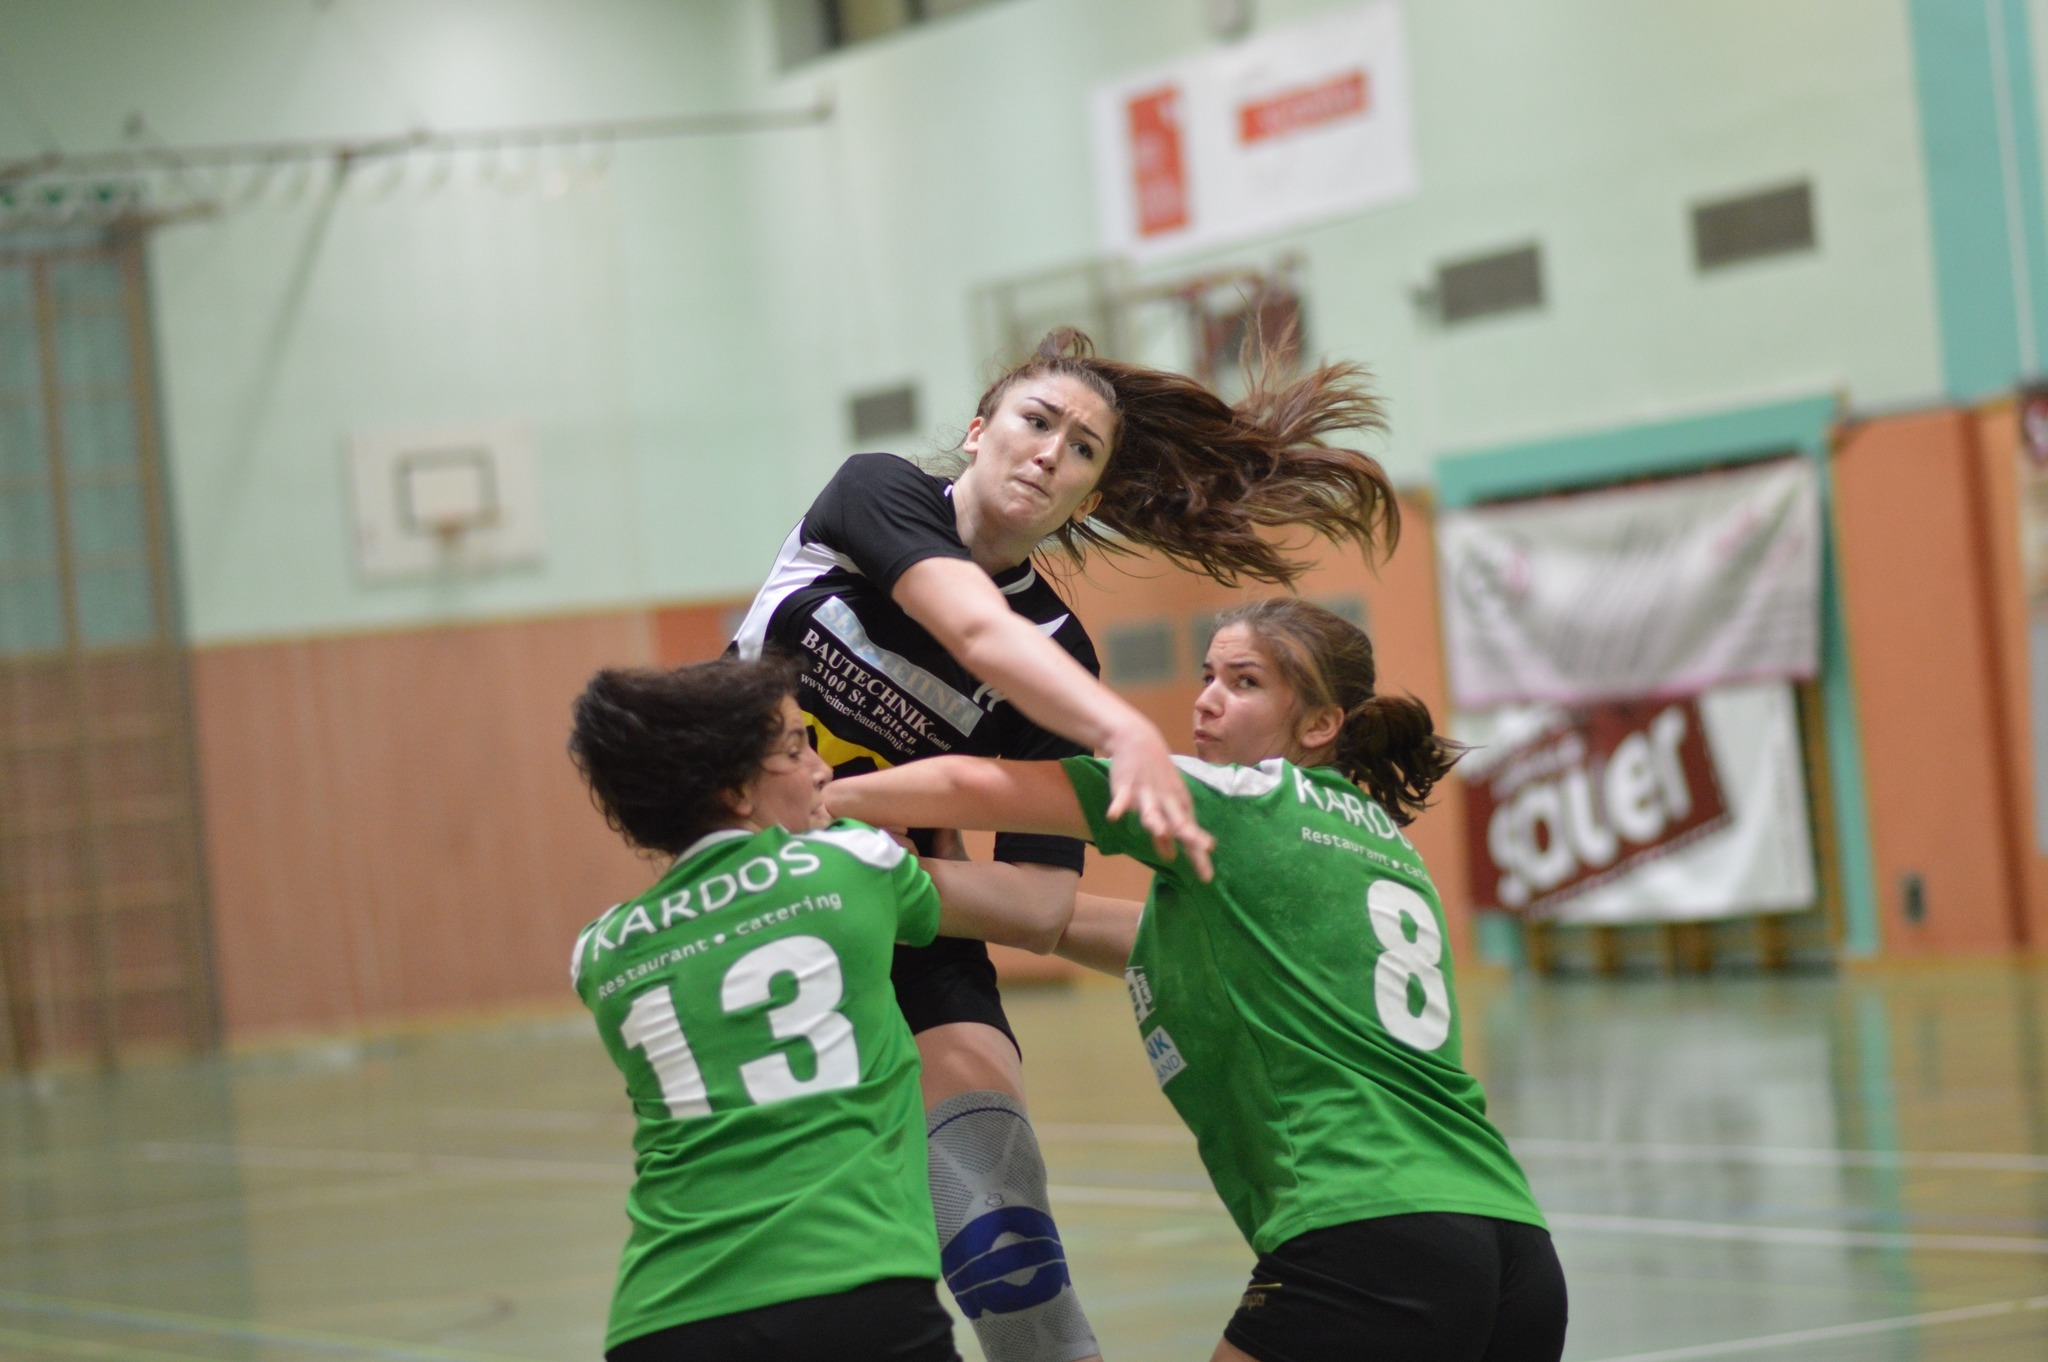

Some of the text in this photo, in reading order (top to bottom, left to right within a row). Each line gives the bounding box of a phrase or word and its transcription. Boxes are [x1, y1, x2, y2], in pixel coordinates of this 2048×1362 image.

[800, 628, 935, 737] BAUTECHNIK
[927, 732, 952, 751] GmbH
[800, 673, 916, 756] www.leitner-bautechnik.at
[813, 662, 917, 745] 3100 St. Pölten
[879, 654, 978, 726] LEITNER
[1292, 767, 1423, 862] KARD
[1301, 826, 1390, 867] Restaurant
[592, 840, 820, 962] KARDOS
[597, 893, 842, 999] Restaurant catering
[1367, 879, 1451, 1051] 8
[620, 935, 860, 1119] 13
[1156, 1054, 1181, 1079] AND
